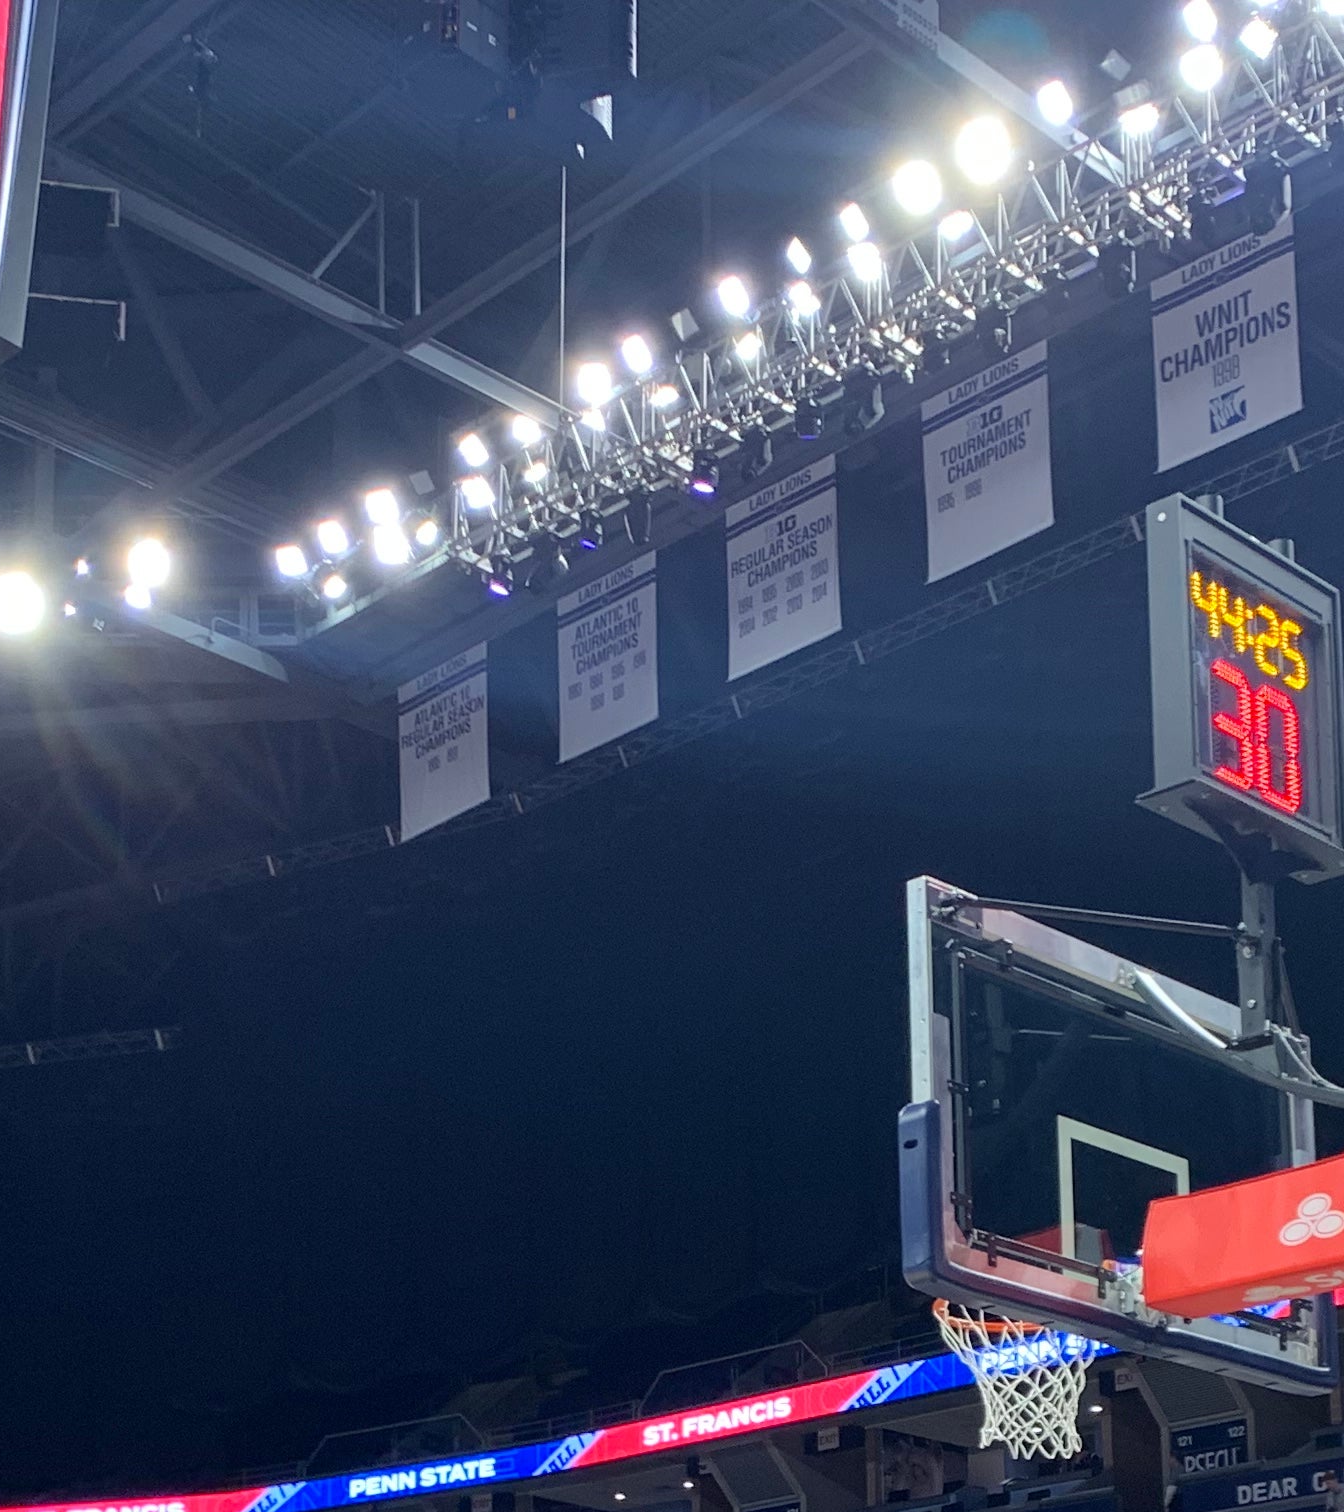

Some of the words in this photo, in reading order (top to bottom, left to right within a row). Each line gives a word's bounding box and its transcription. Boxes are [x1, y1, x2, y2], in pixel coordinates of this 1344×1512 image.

[1181, 259, 1216, 285] LADY
[1220, 236, 1261, 266] LIONS
[1195, 289, 1253, 338] WNIT
[1160, 301, 1292, 382] CHAMPIONS
[948, 378, 979, 404] LADY
[983, 357, 1020, 388] LIONS
[940, 408, 1032, 467] TOURNAMENT
[947, 431, 1027, 484] CHAMPIONS
[749, 487, 778, 512] LADY
[780, 470, 811, 496] LIONS
[731, 539, 784, 579] REGULAR
[788, 514, 833, 549] SEASON
[748, 541, 817, 588] CHAMPIONS
[578, 582, 602, 603] LADY
[571, 611, 643, 661] TOURNAMENT
[575, 604, 623, 642] ATLANTIC
[626, 597, 638, 618] 10
[576, 632, 639, 676] CHAMPIONS
[414, 691, 457, 727] ATLANTIC
[415, 716, 472, 760] CHAMPIONS
[1211, 658, 1303, 814] 30
[642, 1424, 679, 1447] ST.
[683, 1397, 792, 1439] FRANCIS
[349, 1472, 418, 1498] PENN
[421, 1458, 496, 1487] STATE
[1237, 1477, 1298, 1505] DEAR
